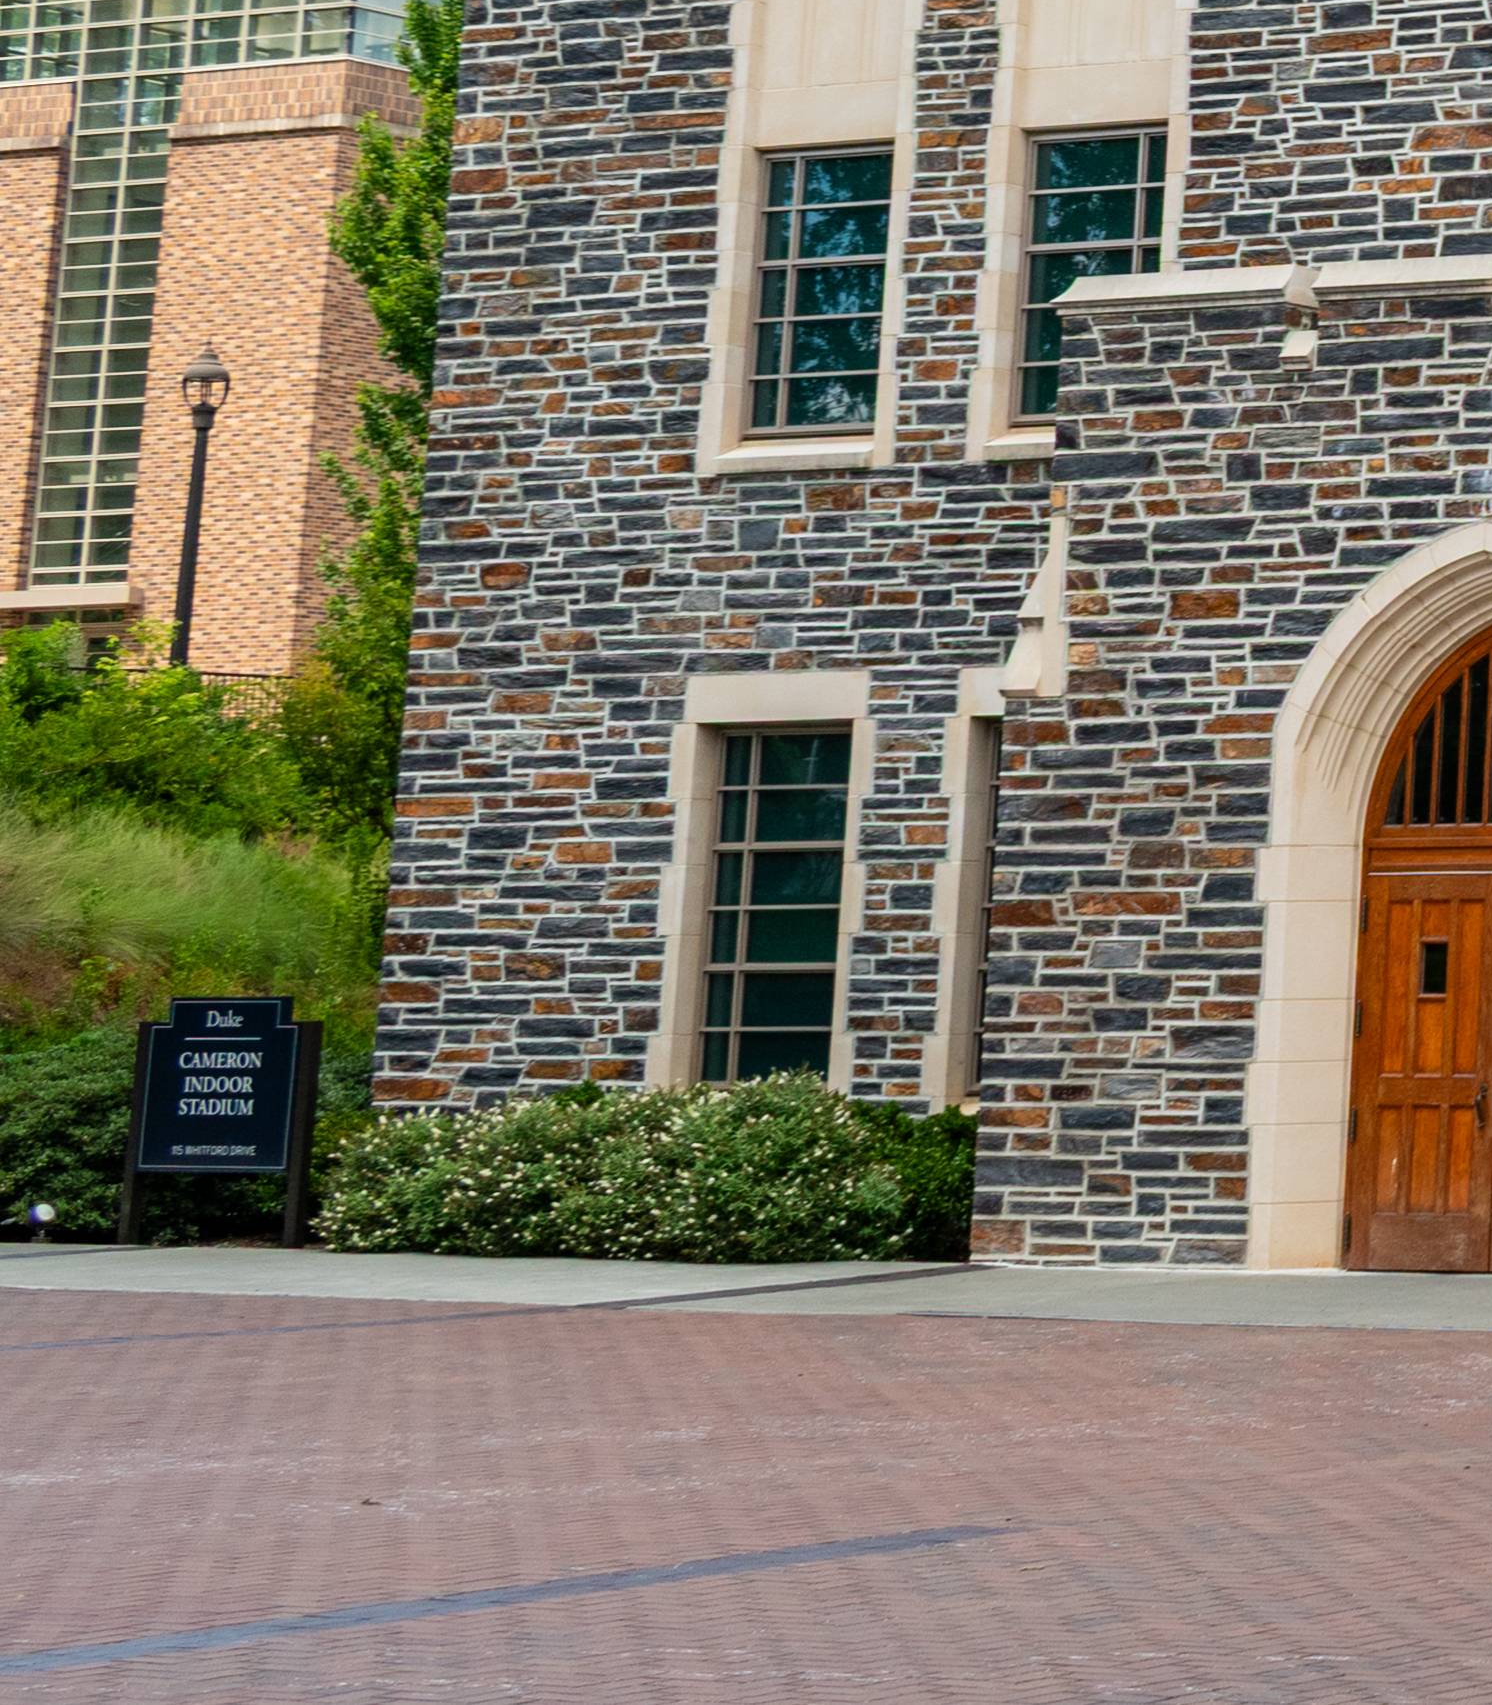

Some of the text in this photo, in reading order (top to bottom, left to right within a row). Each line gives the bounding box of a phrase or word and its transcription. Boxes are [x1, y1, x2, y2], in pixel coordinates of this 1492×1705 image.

[205, 1009, 245, 1028] Duke
[178, 1051, 264, 1069] CAMERON
[183, 1076, 254, 1093] INDOOR
[177, 1098, 255, 1116] STADIUM
[230, 1145, 257, 1156] DRIVE
